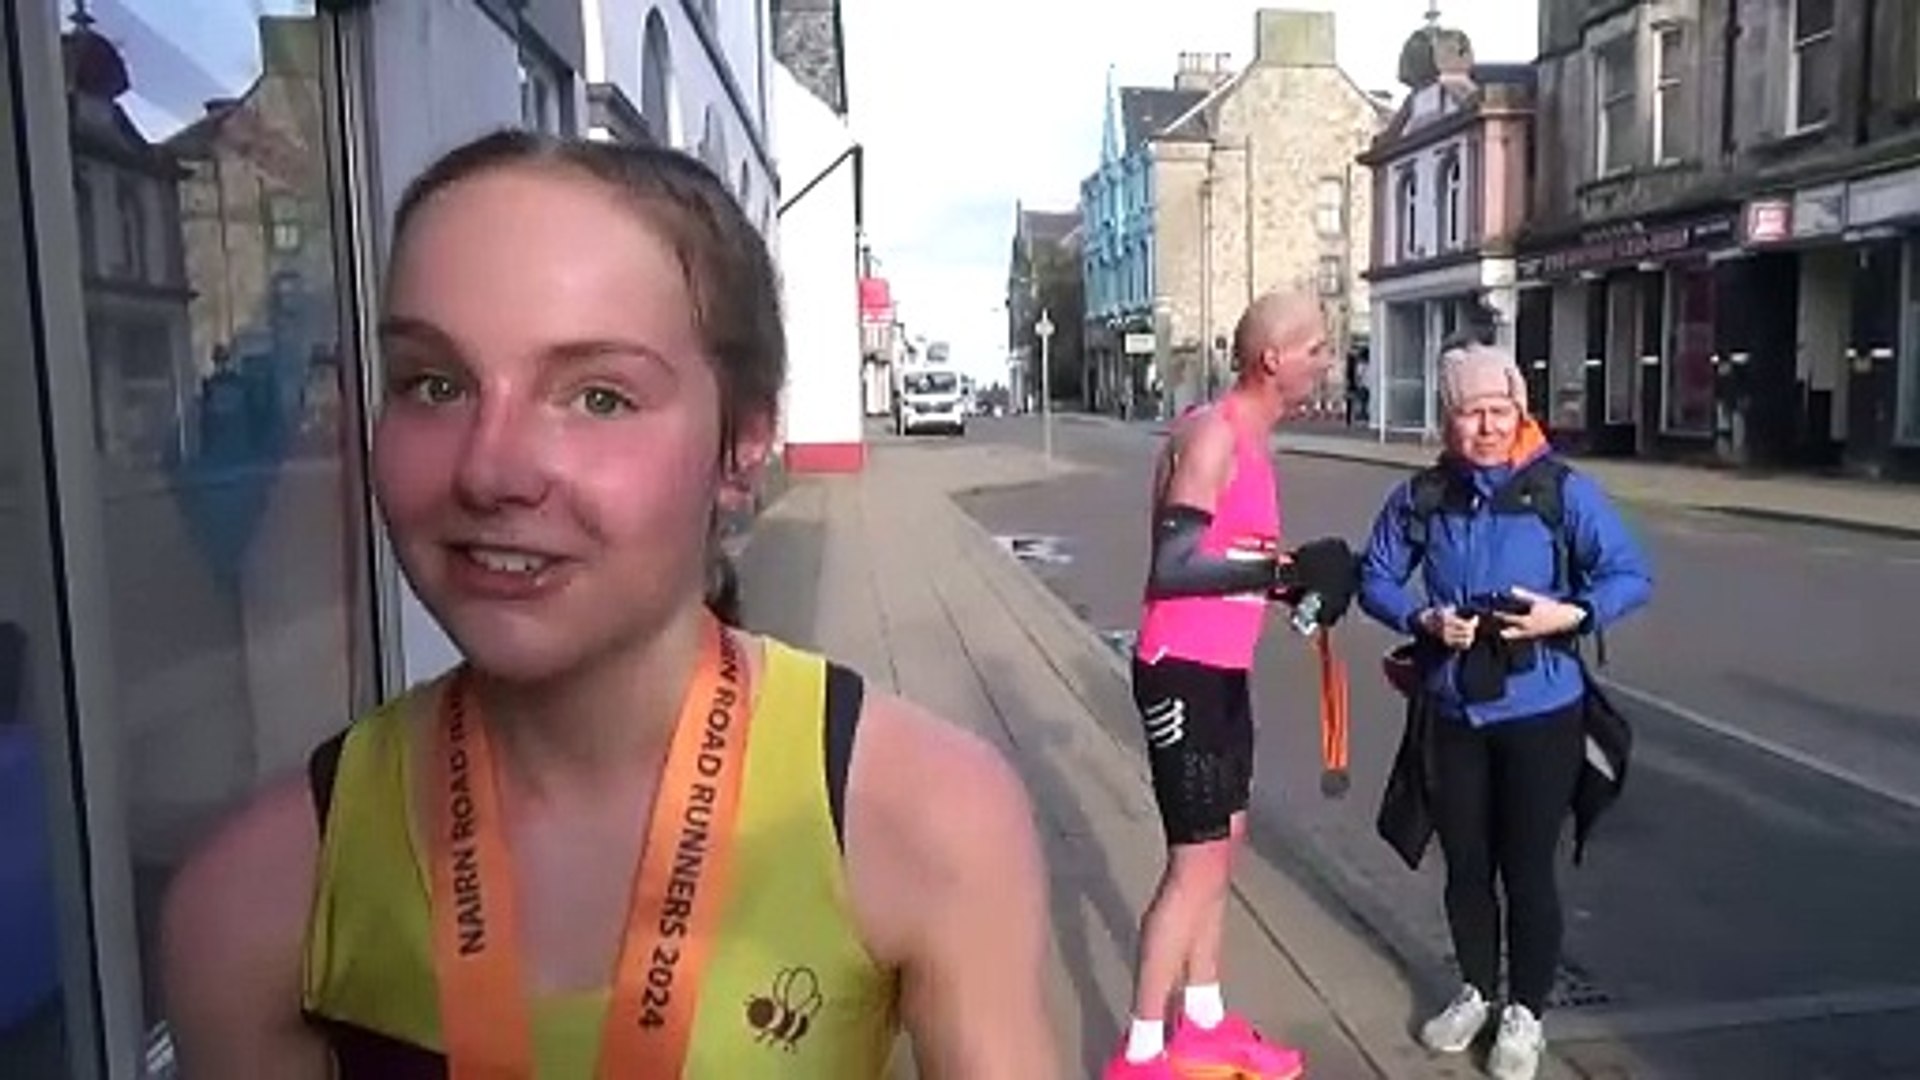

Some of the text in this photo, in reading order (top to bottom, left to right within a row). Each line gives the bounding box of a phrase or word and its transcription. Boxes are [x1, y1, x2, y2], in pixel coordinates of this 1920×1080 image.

[698, 686, 737, 777] ROAD
[450, 750, 475, 842] ROAD
[454, 847, 485, 957] NAIRN
[660, 784, 714, 939] RUNNERS
[640, 946, 681, 1031] 2024
